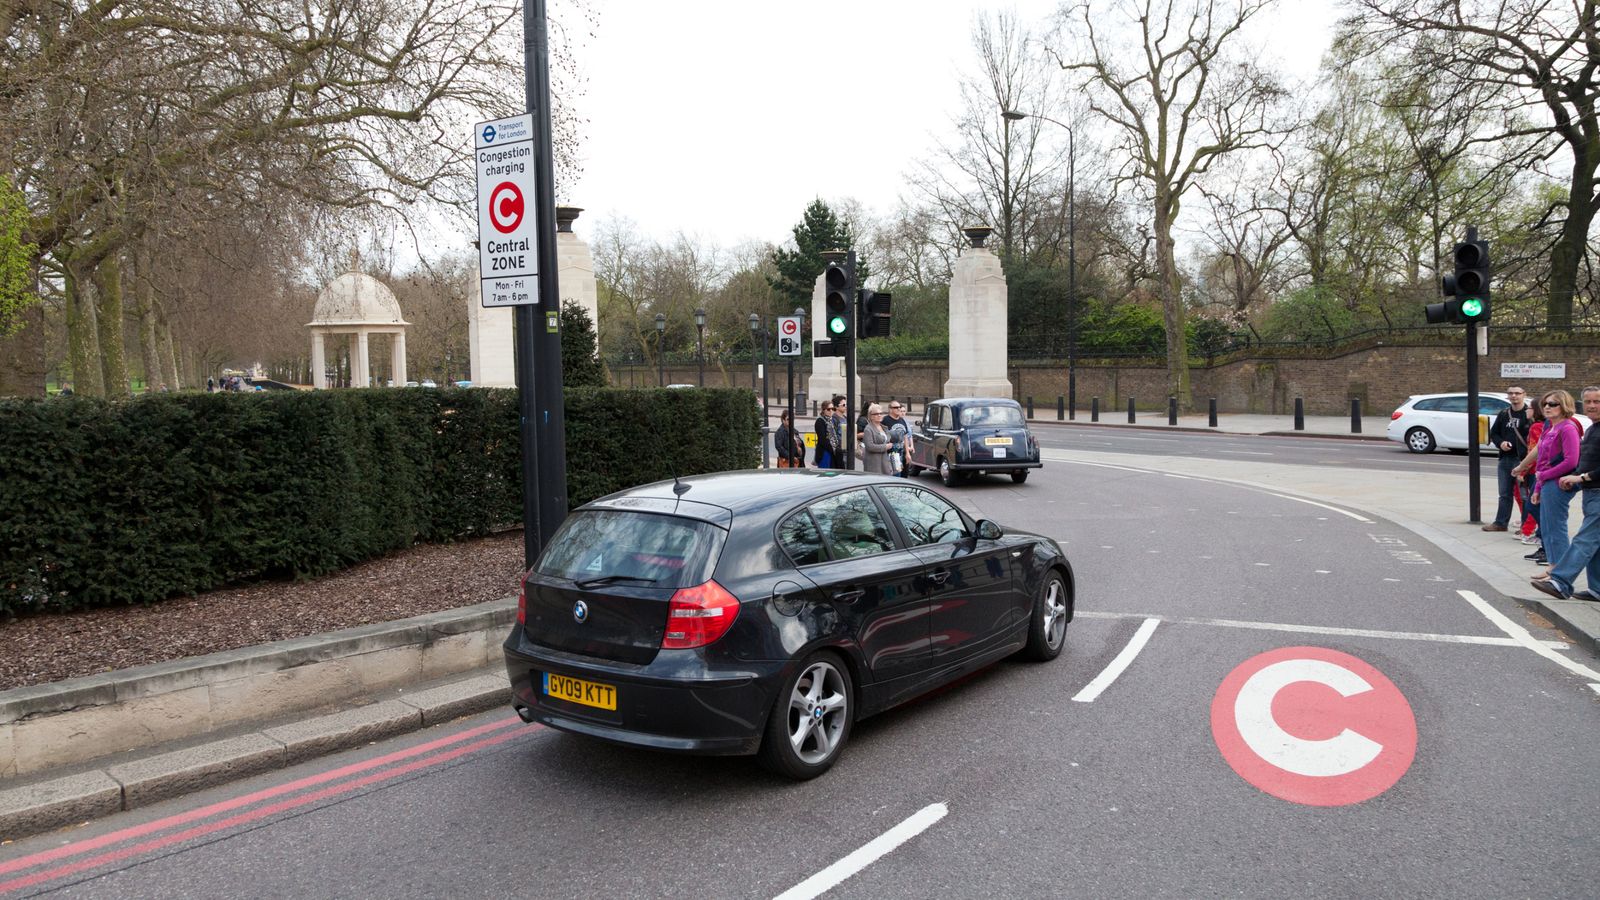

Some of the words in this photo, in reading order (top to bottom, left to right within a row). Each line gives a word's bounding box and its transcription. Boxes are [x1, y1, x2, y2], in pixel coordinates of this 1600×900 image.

[498, 121, 524, 131] Transport
[498, 132, 506, 140] for
[507, 129, 527, 138] London
[480, 146, 531, 163] Congestion
[485, 161, 525, 176] charging
[487, 237, 530, 254] Central
[492, 255, 525, 271] ZONE
[550, 675, 582, 699] GY09
[585, 683, 614, 706] KTT
[1234, 659, 1384, 777] C
